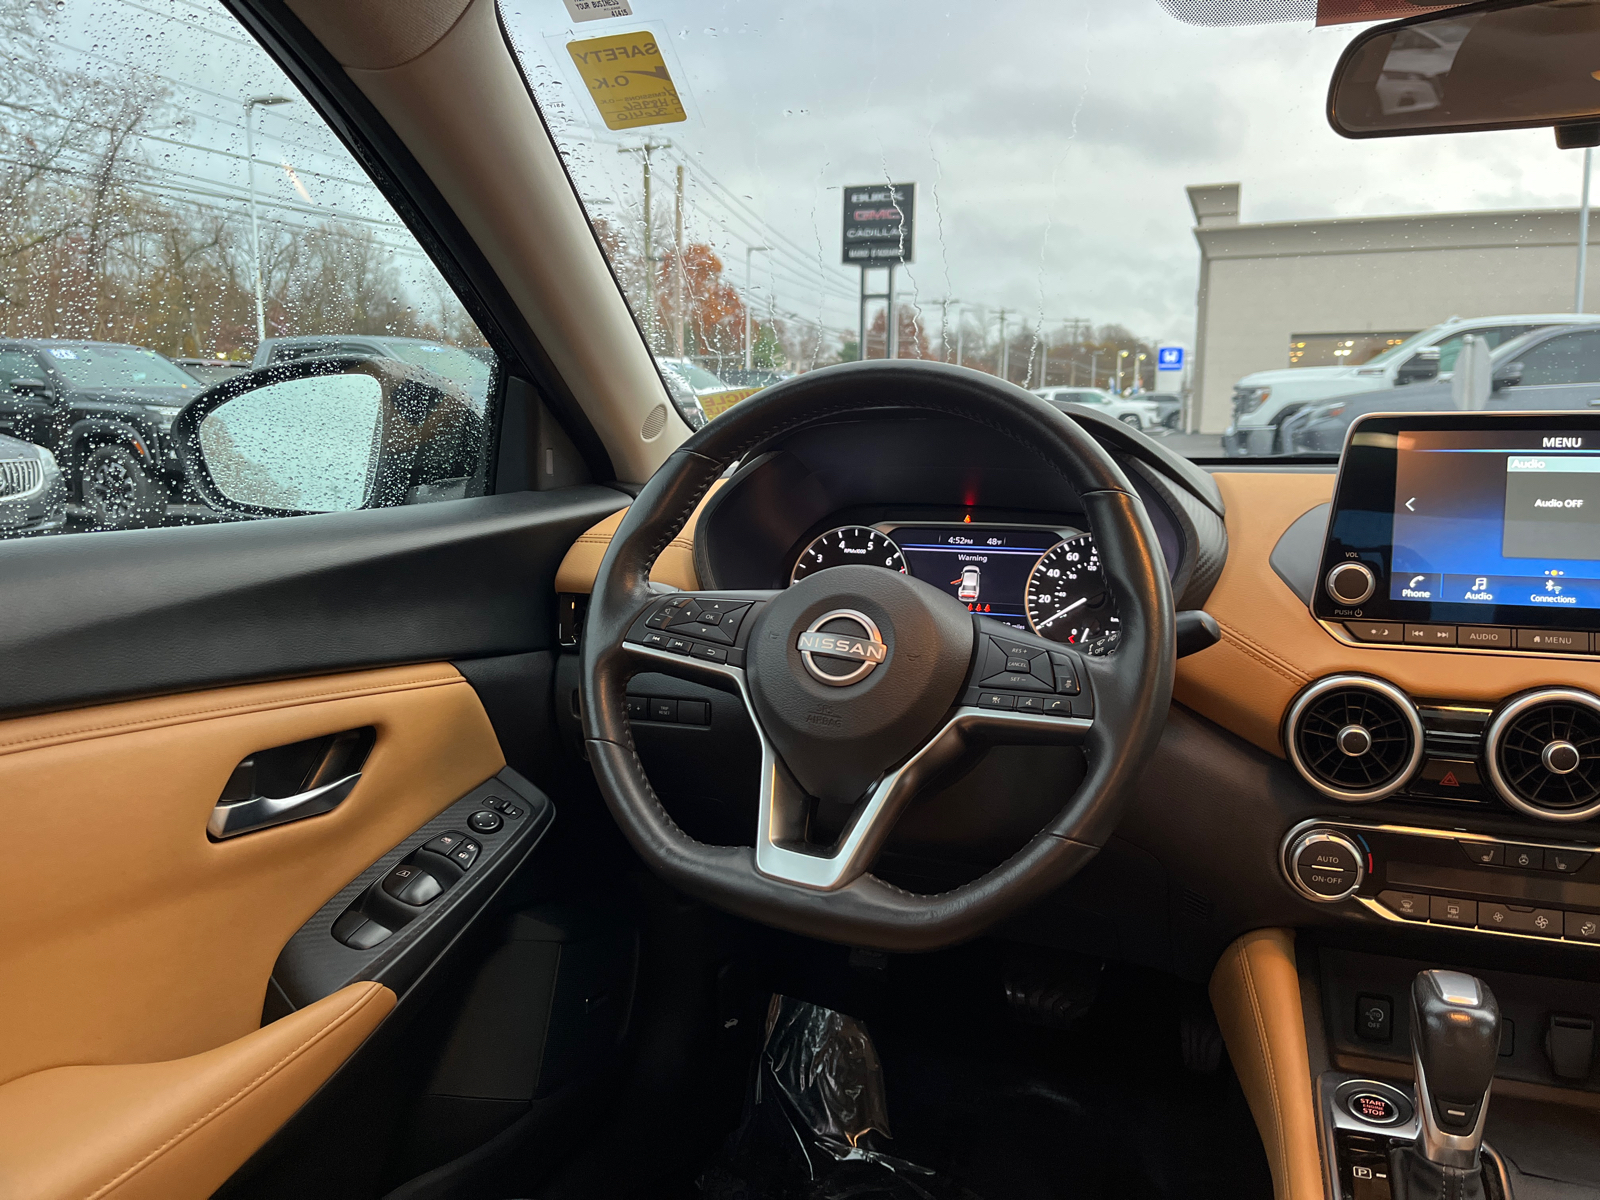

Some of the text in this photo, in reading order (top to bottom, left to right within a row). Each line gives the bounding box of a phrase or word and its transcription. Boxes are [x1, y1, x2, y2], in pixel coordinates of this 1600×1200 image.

[853, 208, 900, 221] GMC
[1542, 437, 1582, 448] MENU
[1511, 459, 1546, 469] Audio
[1534, 499, 1583, 508] Audio OFF
[838, 541, 846, 549] 4
[867, 542, 874, 550] 5
[816, 554, 823, 563] 3
[957, 554, 988, 564] Warning
[1066, 552, 1079, 561] 60
[885, 557, 893, 566] 6
[1046, 568, 1060, 578] 40
[1402, 589, 1431, 598] Phone
[1464, 591, 1493, 600] Audio
[1038, 594, 1051, 604] 20
[1530, 594, 1576, 604] Connections
[1470, 633, 1499, 641] AUDIO
[1545, 636, 1572, 645] MENU
[800, 636, 883, 659] NISSAN
[1316, 854, 1339, 865] AUTO
[1360, 1098, 1385, 1107] START
[1362, 1107, 1385, 1116] STOP
